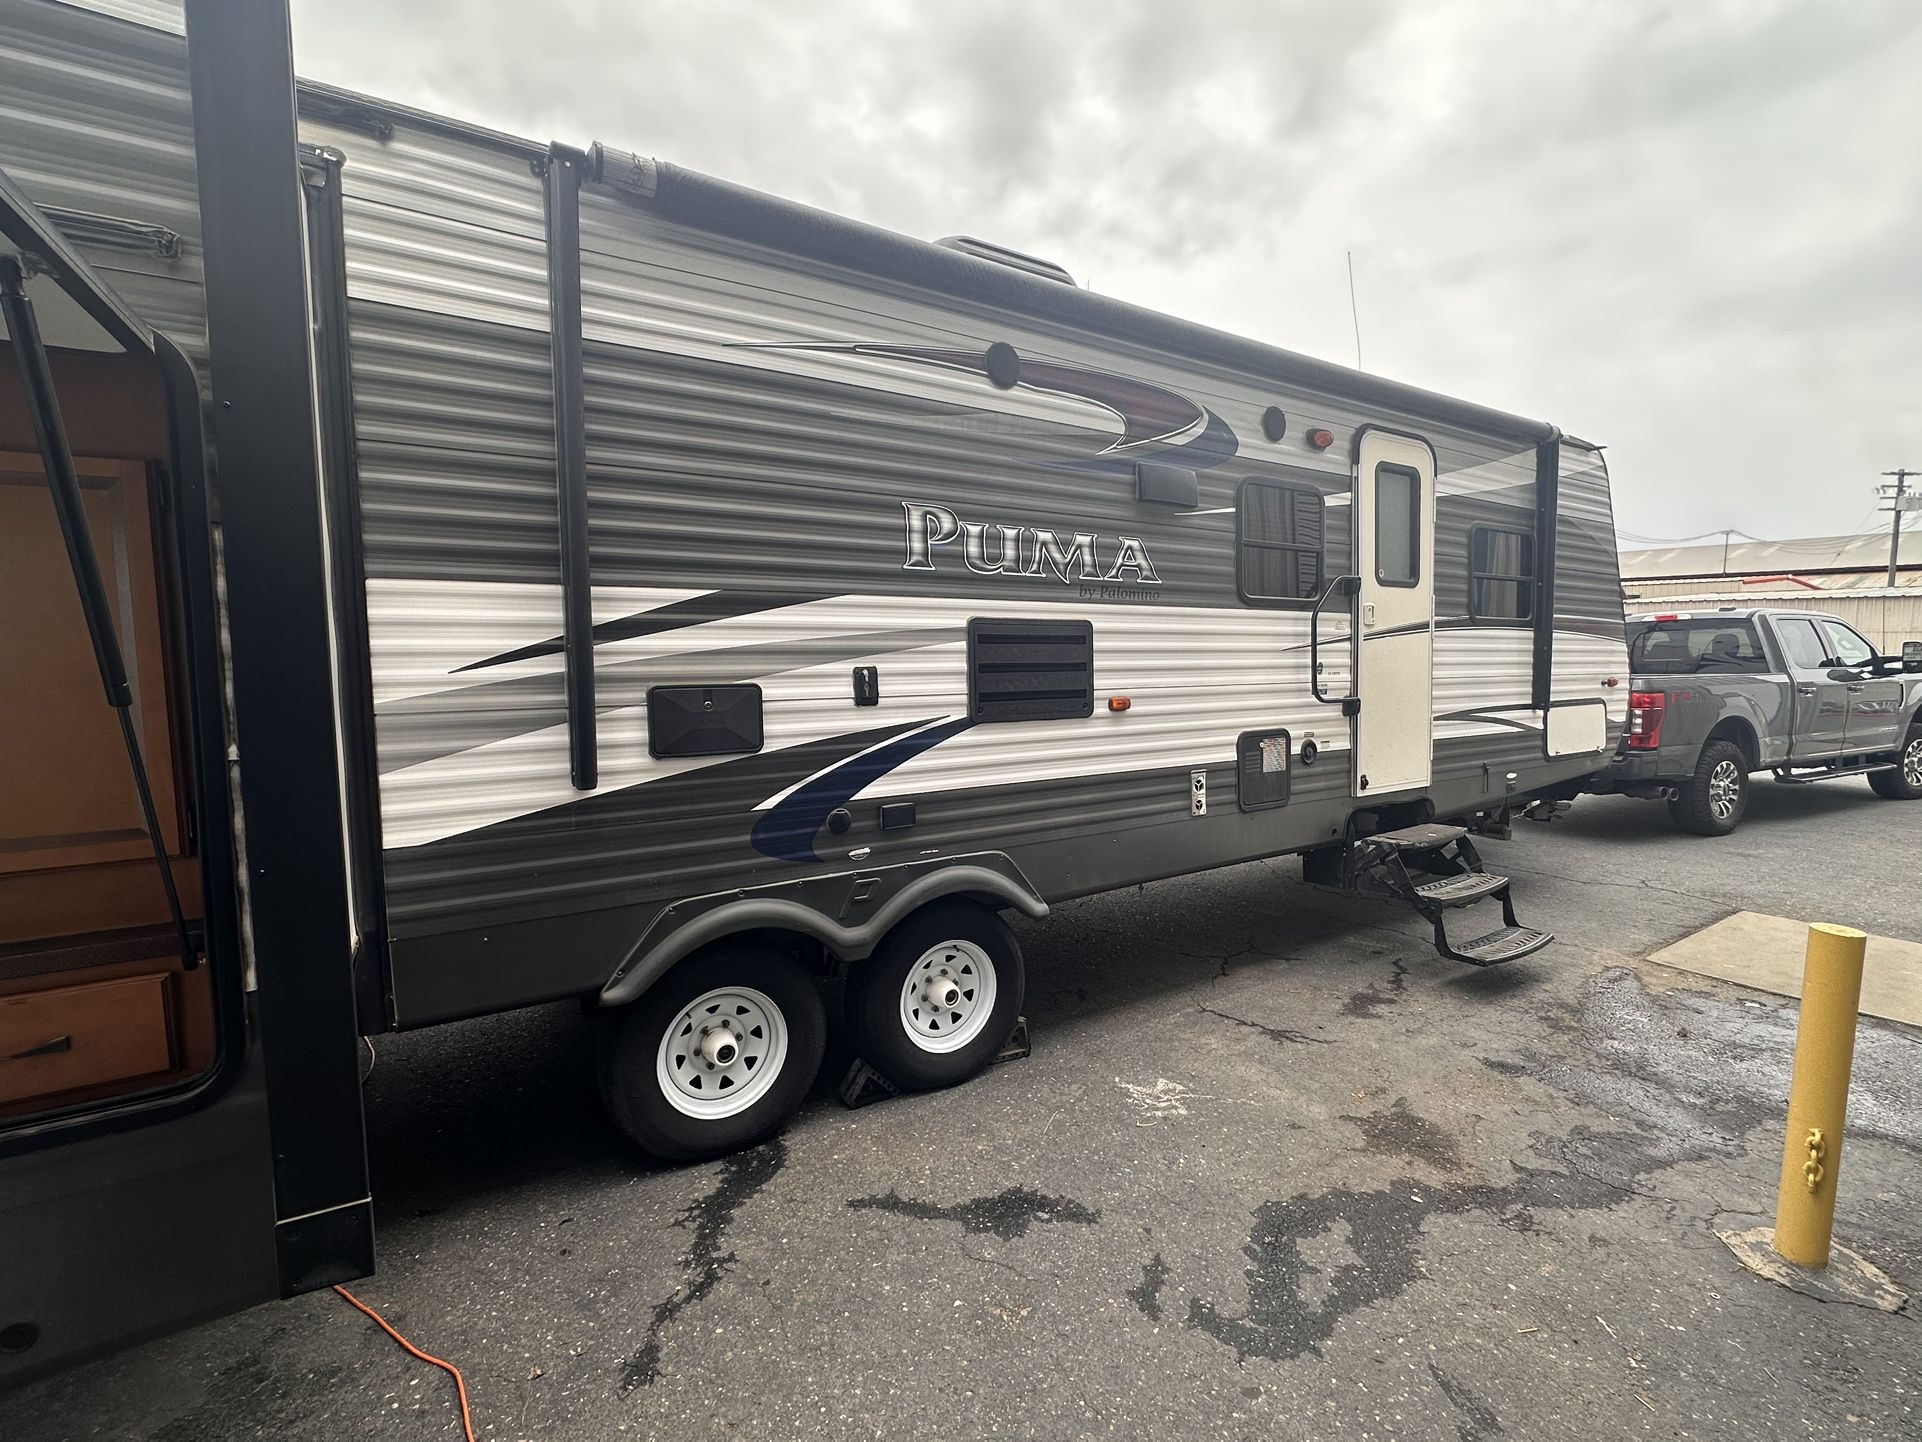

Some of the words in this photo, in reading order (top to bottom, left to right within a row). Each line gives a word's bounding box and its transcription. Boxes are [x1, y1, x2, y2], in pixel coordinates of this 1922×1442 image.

[901, 501, 1163, 584] PUMA
[1078, 585, 1096, 600] by
[1100, 584, 1160, 601] Palomino
